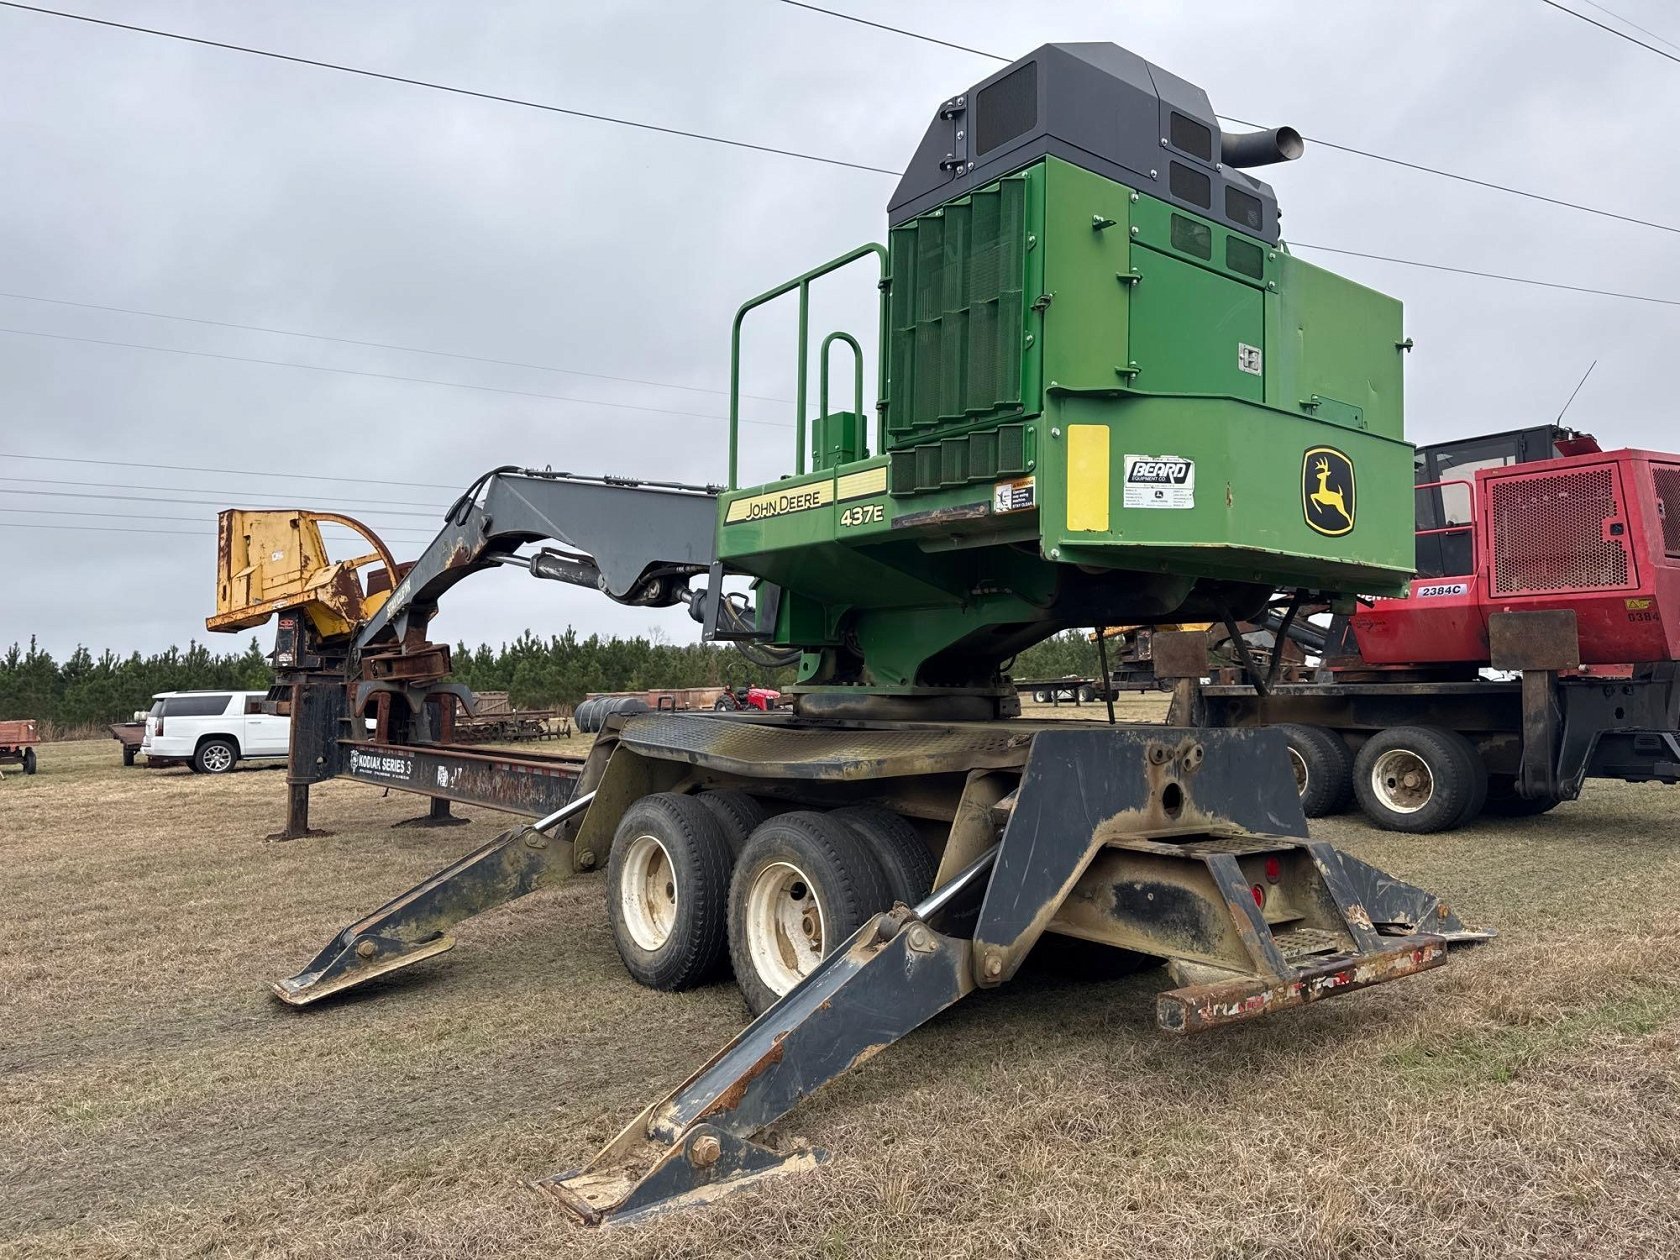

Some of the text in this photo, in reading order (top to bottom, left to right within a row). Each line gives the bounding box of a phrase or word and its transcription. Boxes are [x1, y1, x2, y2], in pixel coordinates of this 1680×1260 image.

[1132, 462, 1187, 484] BEARD
[745, 491, 821, 520] JOHN DEERE
[840, 504, 884, 527] 437E
[1422, 585, 1461, 596] 2384C
[358, 754, 381, 770] KODIAK
[382, 758, 405, 774] SERIES
[406, 760, 412, 775] 3
